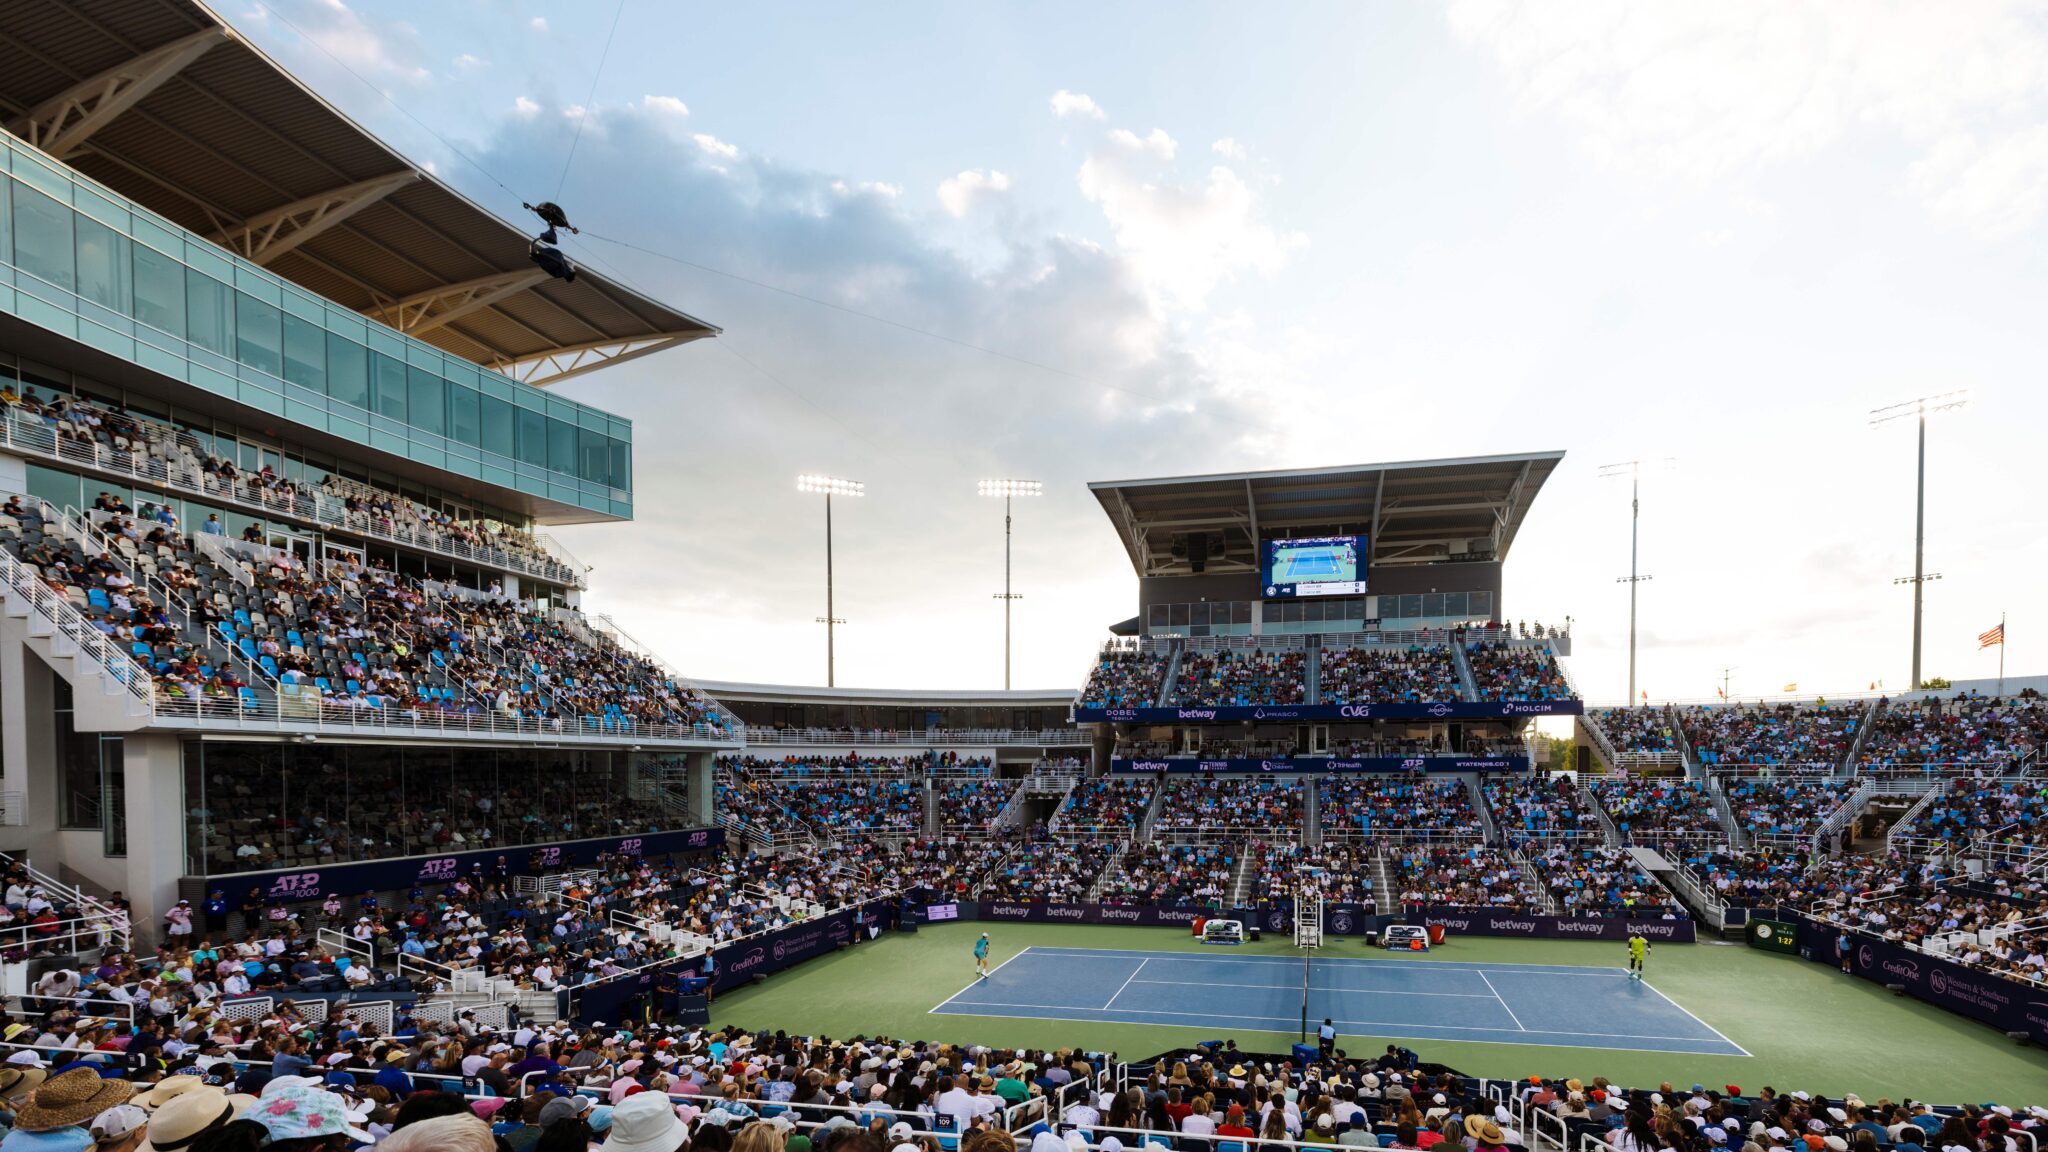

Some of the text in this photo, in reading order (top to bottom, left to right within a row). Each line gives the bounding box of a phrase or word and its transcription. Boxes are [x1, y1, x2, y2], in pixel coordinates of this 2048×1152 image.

[1178, 709, 1217, 720] betway
[1341, 705, 1370, 717] CVG
[1132, 761, 1169, 772] betway
[1401, 759, 1424, 768] ATP
[688, 832, 708, 842] ATP
[619, 839, 642, 850] ATP
[418, 858, 457, 875] ATP
[438, 871, 457, 880] 1000
[269, 873, 320, 892] ATP
[295, 888, 320, 898] 1000
[992, 905, 1029, 918] betway
[1046, 906, 1084, 920] betway
[1101, 908, 1140, 921] betway
[1490, 919, 1536, 932] betway
[1557, 921, 1604, 934] betway
[1626, 923, 1674, 936] betway
[1777, 936, 1793, 945] 1:27
[1946, 976, 2009, 1004] Western & Southern
[1948, 986, 1998, 1013] Financial Group
